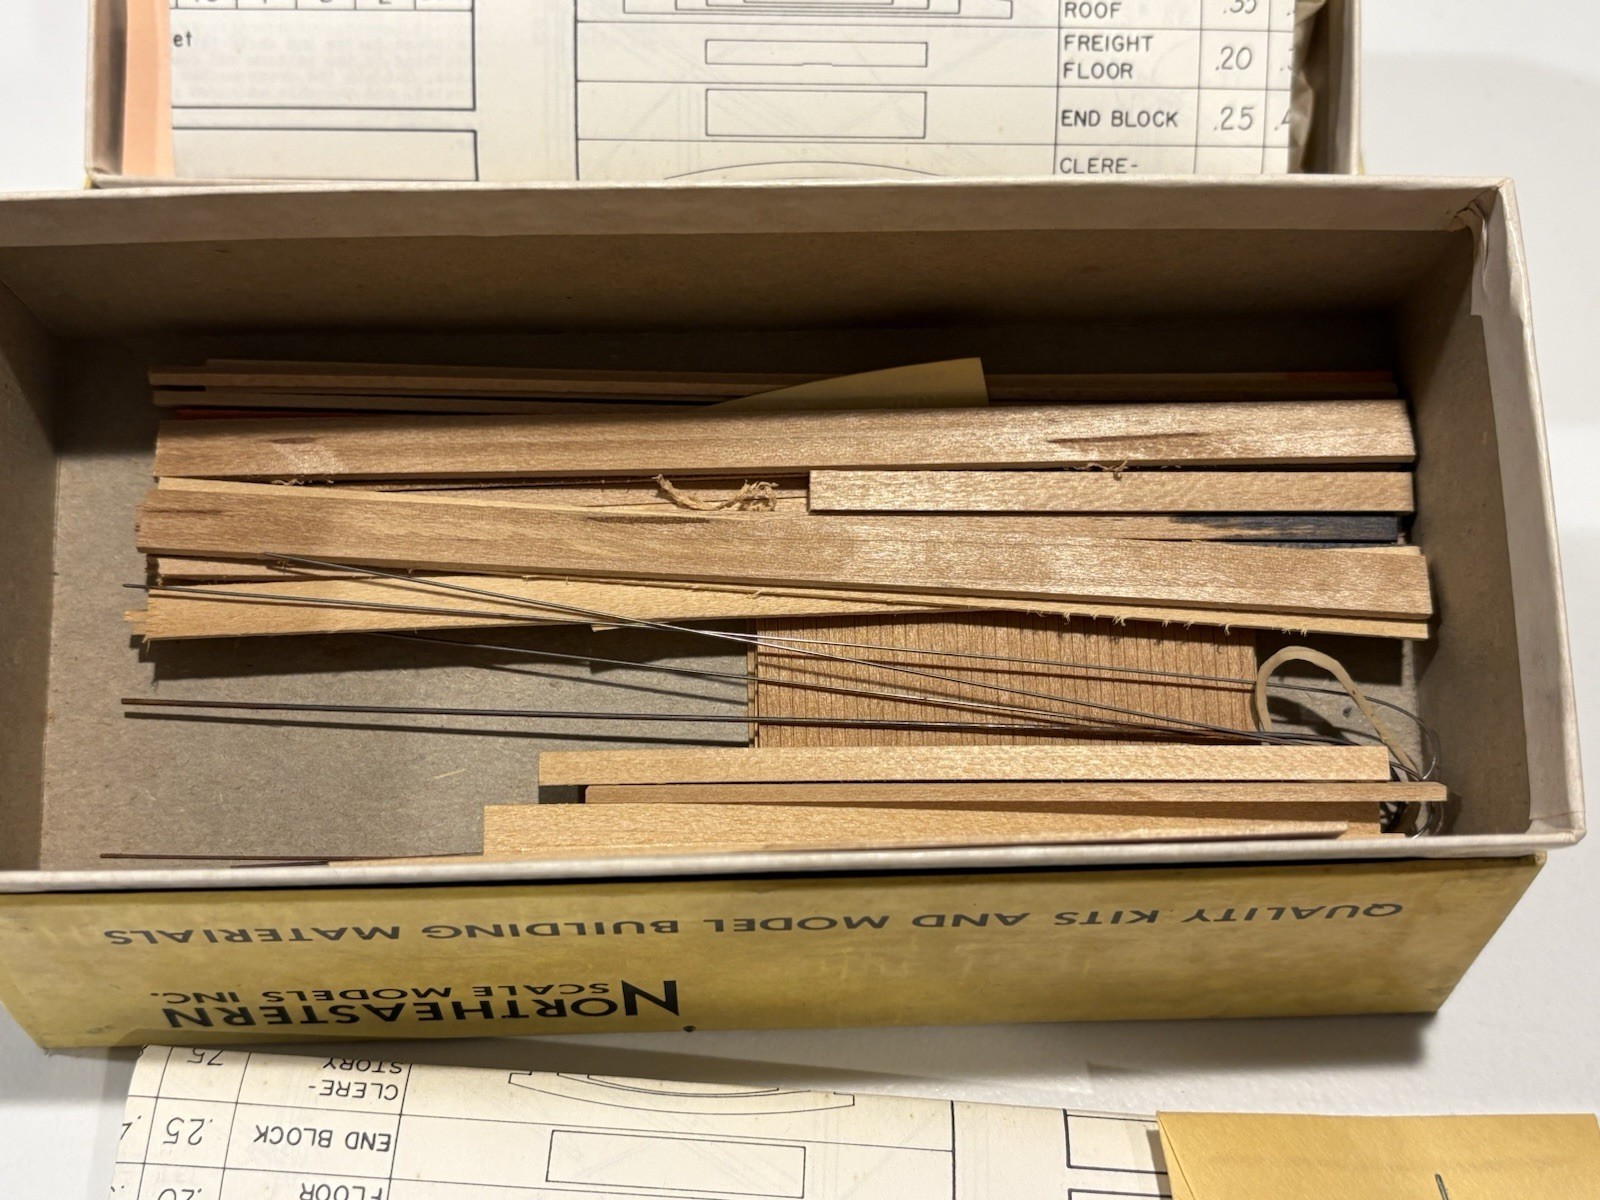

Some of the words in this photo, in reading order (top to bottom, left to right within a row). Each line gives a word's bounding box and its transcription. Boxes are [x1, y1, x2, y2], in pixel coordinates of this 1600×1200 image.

[1064, 2, 1121, 18] ROOF
[1063, 34, 1154, 52] FREIGHT
[1215, 46, 1253, 70] .20
[1063, 61, 1133, 79] FLOOR
[1060, 109, 1101, 127] END
[1110, 110, 1178, 128] BLOCK
[1213, 106, 1255, 131] .25
[1059, 157, 1139, 174] CLERE-
[912, 913, 1030, 927] AND
[1054, 910, 1159, 925] KITS
[1181, 904, 1402, 922] QUALITY
[422, 920, 678, 939] BUILDING
[703, 916, 889, 932] MODEL
[104, 926, 400, 945] MATERIALS
[150, 992, 240, 1004] INC.
[262, 987, 452, 1002] MODELS
[472, 983, 609, 997] SCALE
[162, 980, 680, 1028] NORTHEASTERN
[323, 1057, 403, 1074] STORY
[308, 1079, 399, 1101] CLERE-
[163, 1116, 213, 1146] .25
[253, 1125, 334, 1148] BLOCK
[345, 1131, 392, 1152] END
[299, 1182, 382, 1200] FLOOR
